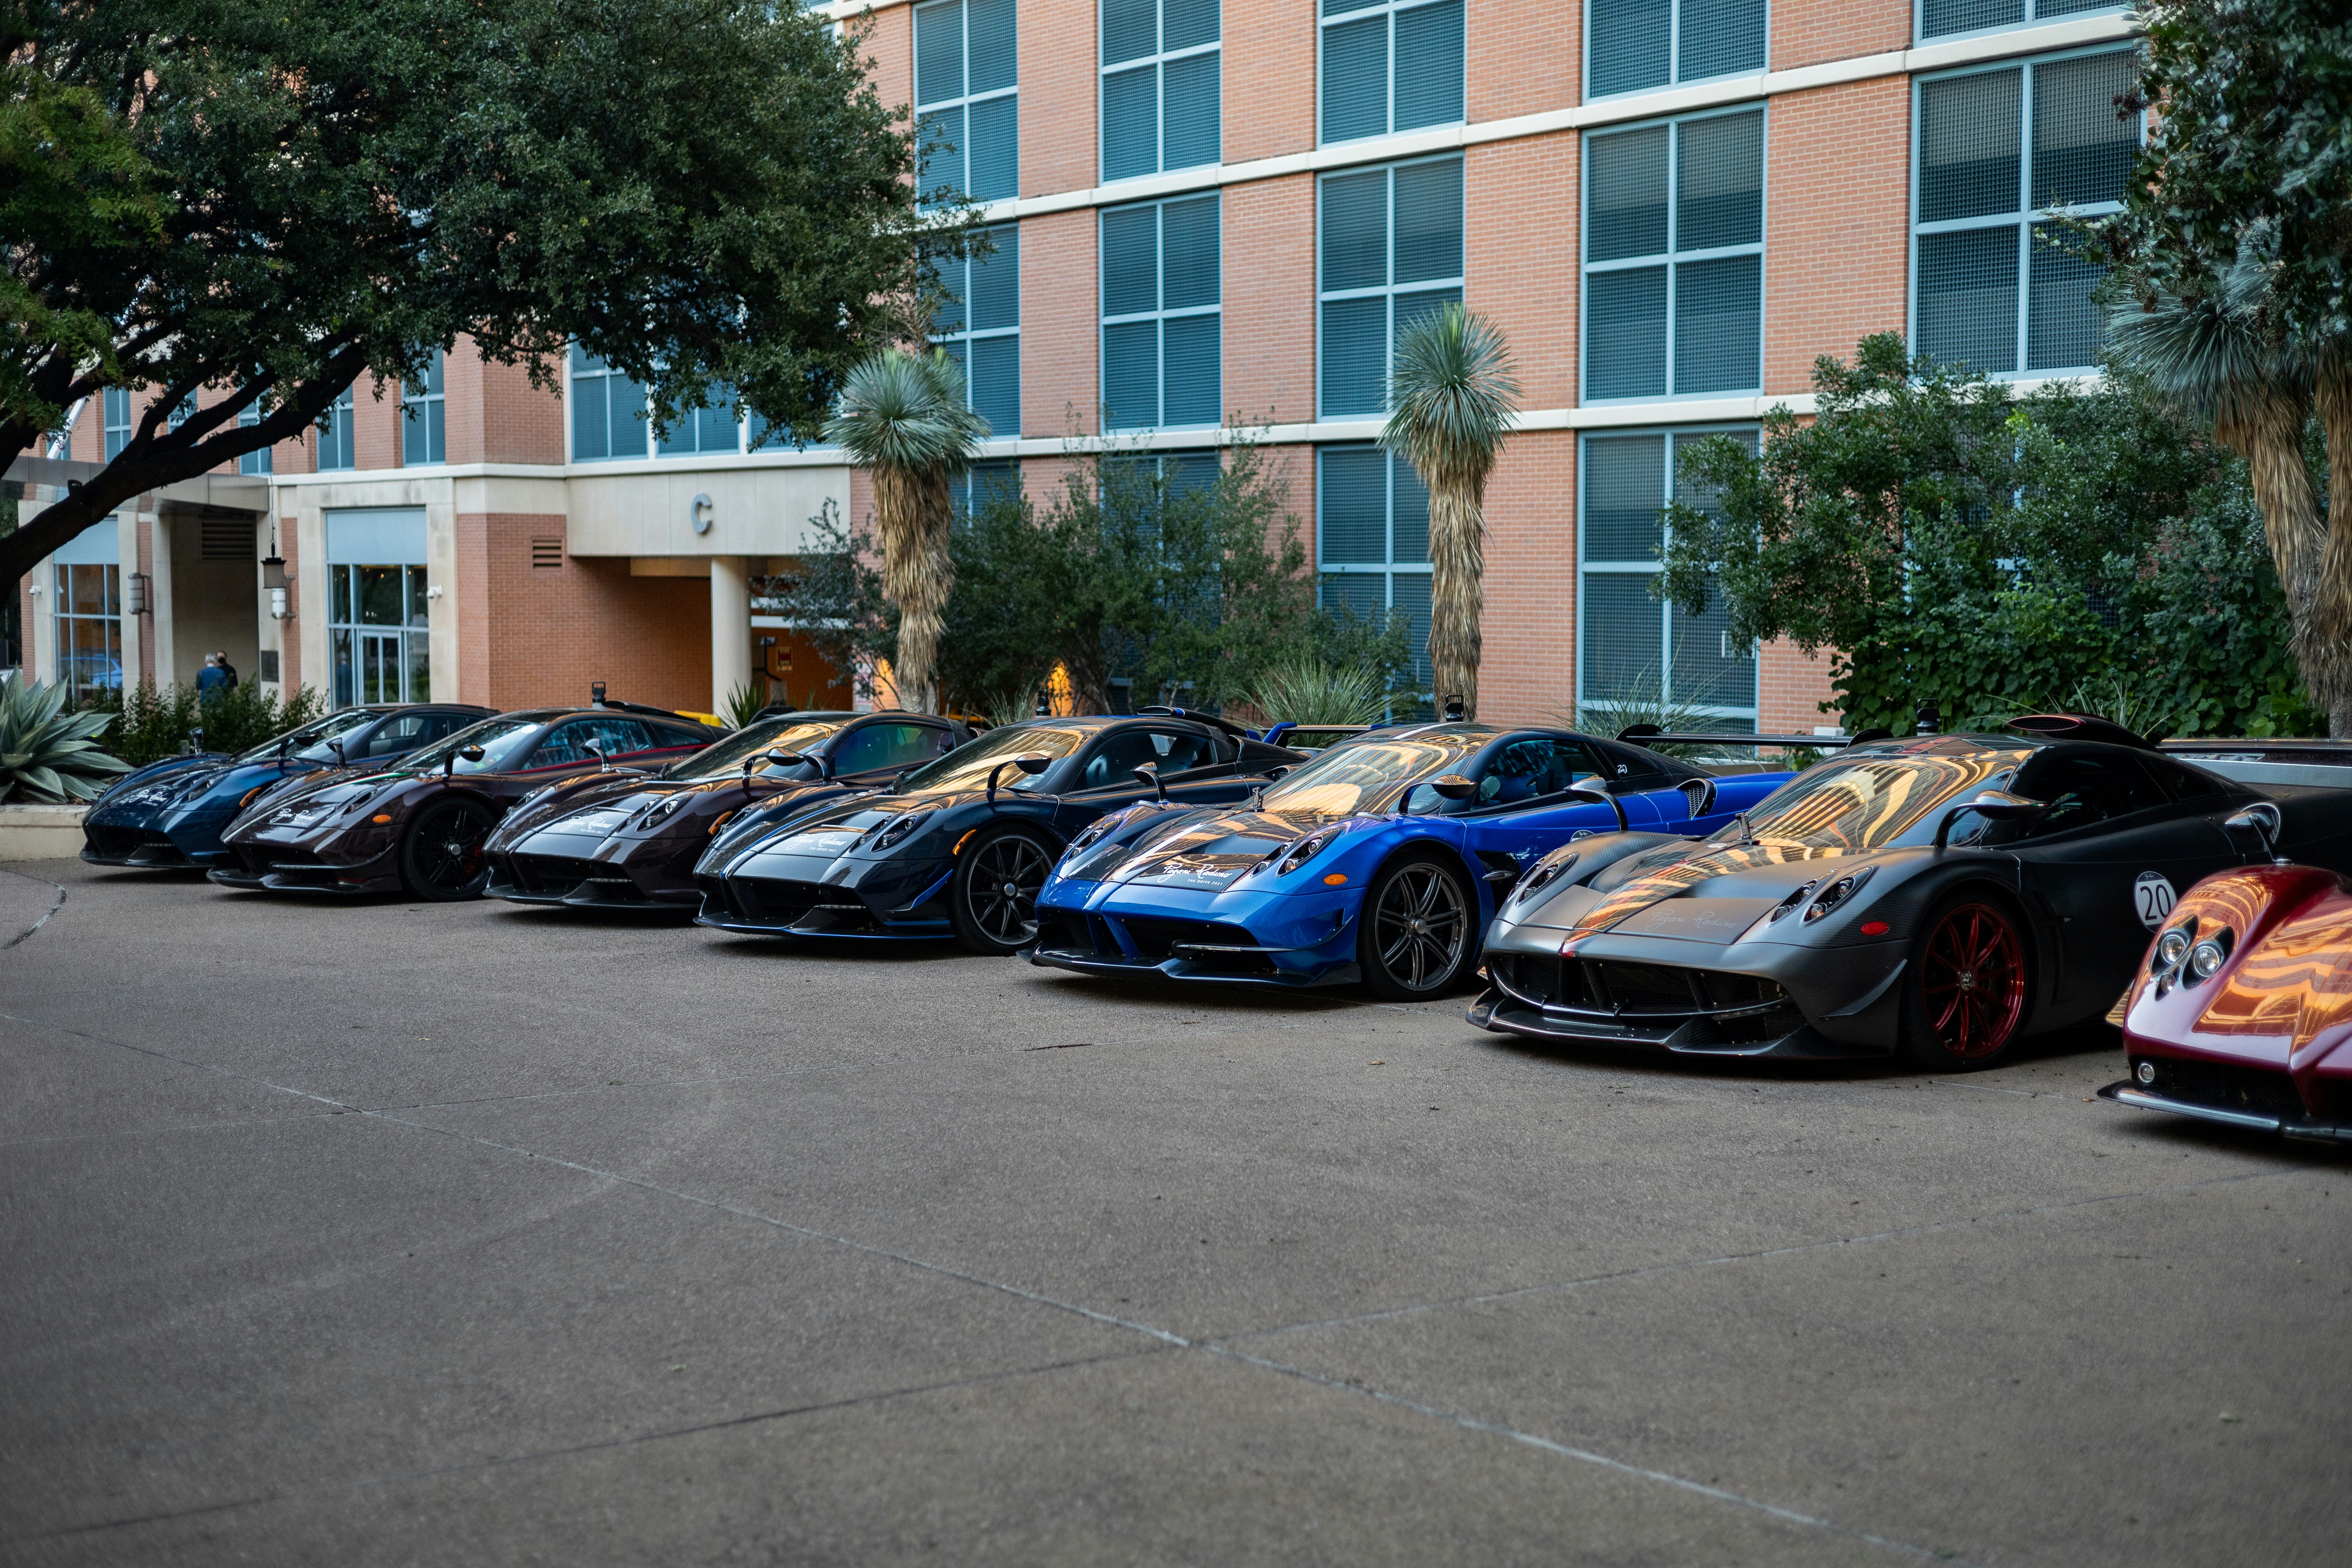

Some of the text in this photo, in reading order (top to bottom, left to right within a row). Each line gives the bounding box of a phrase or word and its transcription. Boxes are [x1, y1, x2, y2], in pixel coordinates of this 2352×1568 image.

[691, 493, 712, 534] C
[1617, 764, 1627, 773] 20
[1157, 863, 1233, 883] Pagani Raduno
[2140, 884, 2172, 920] 20
[1645, 909, 1738, 932] Pagani Raduno
